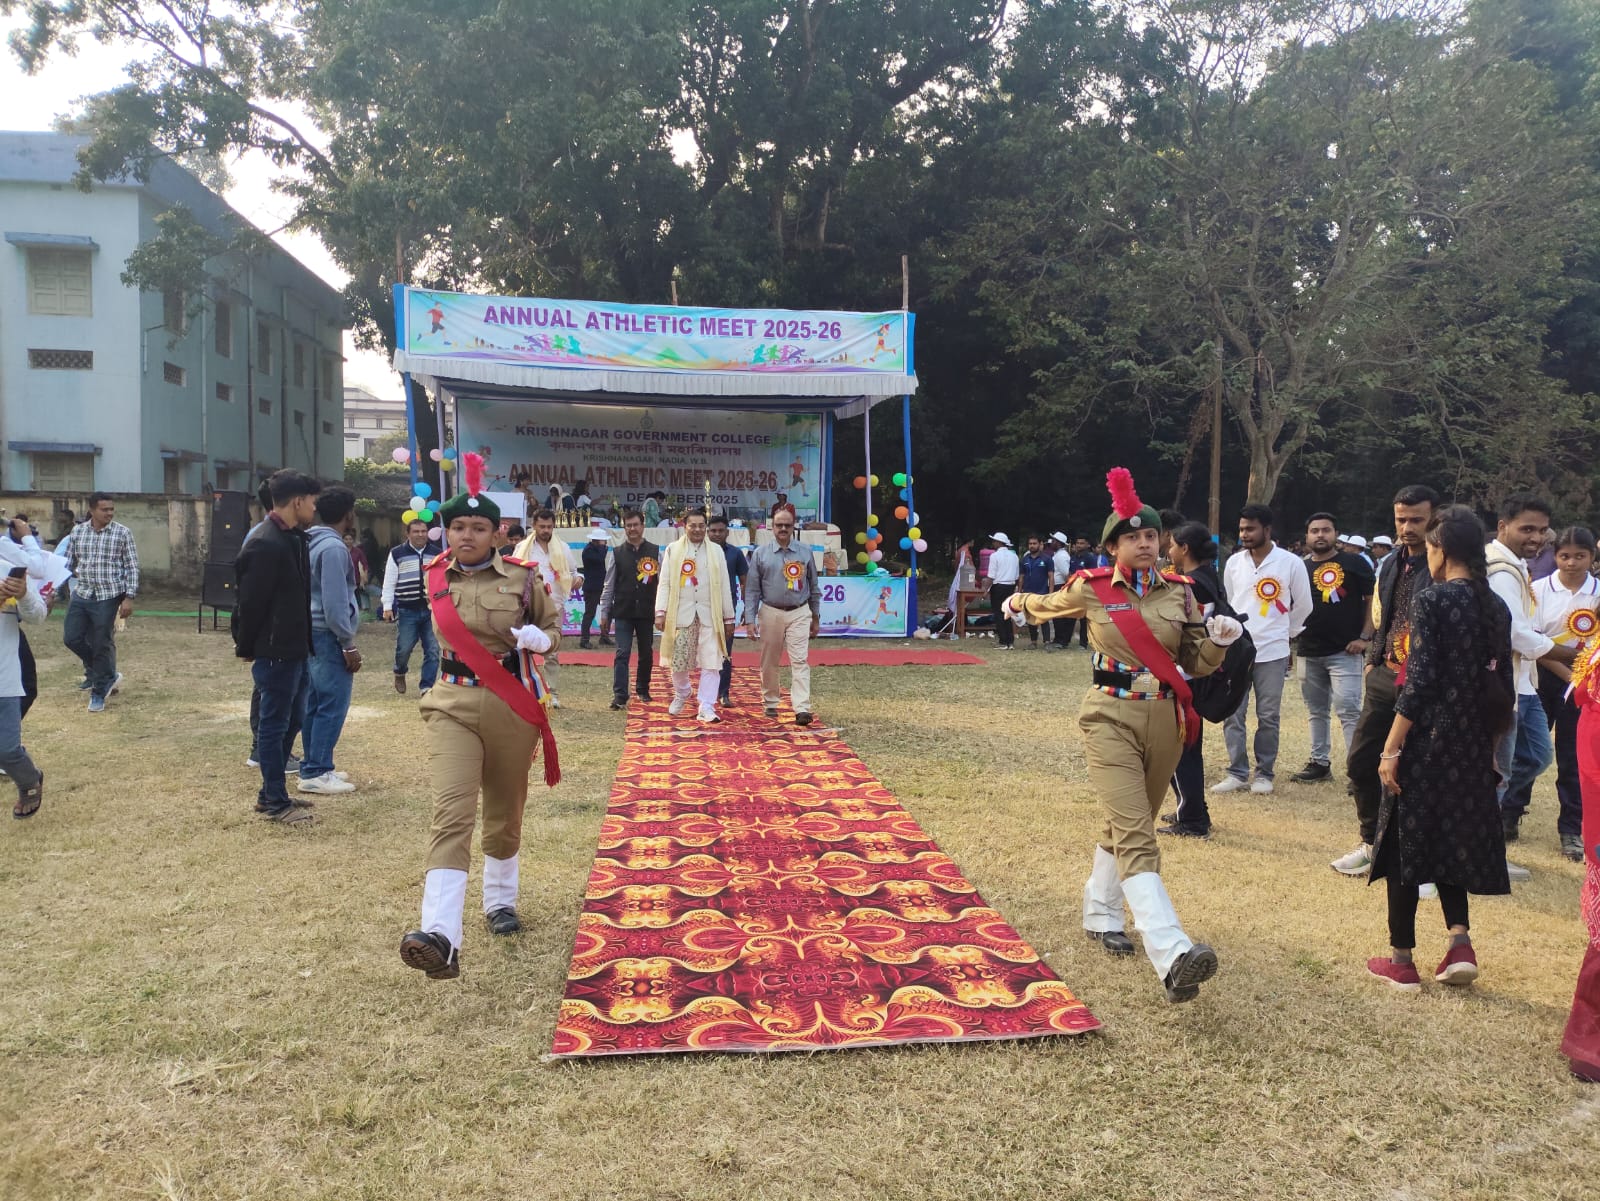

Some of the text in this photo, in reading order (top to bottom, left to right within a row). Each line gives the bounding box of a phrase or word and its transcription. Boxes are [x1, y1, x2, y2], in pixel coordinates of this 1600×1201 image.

[483, 305, 842, 340] ANNUAL ATHLETIC MEET 2025-26
[515, 425, 772, 445] KRISHNAGAR GOVERNMENT COLLEGE
[508, 463, 778, 492] ANNUAL ATHLETIC MEET 2025-26
[708, 495, 739, 505] 2025
